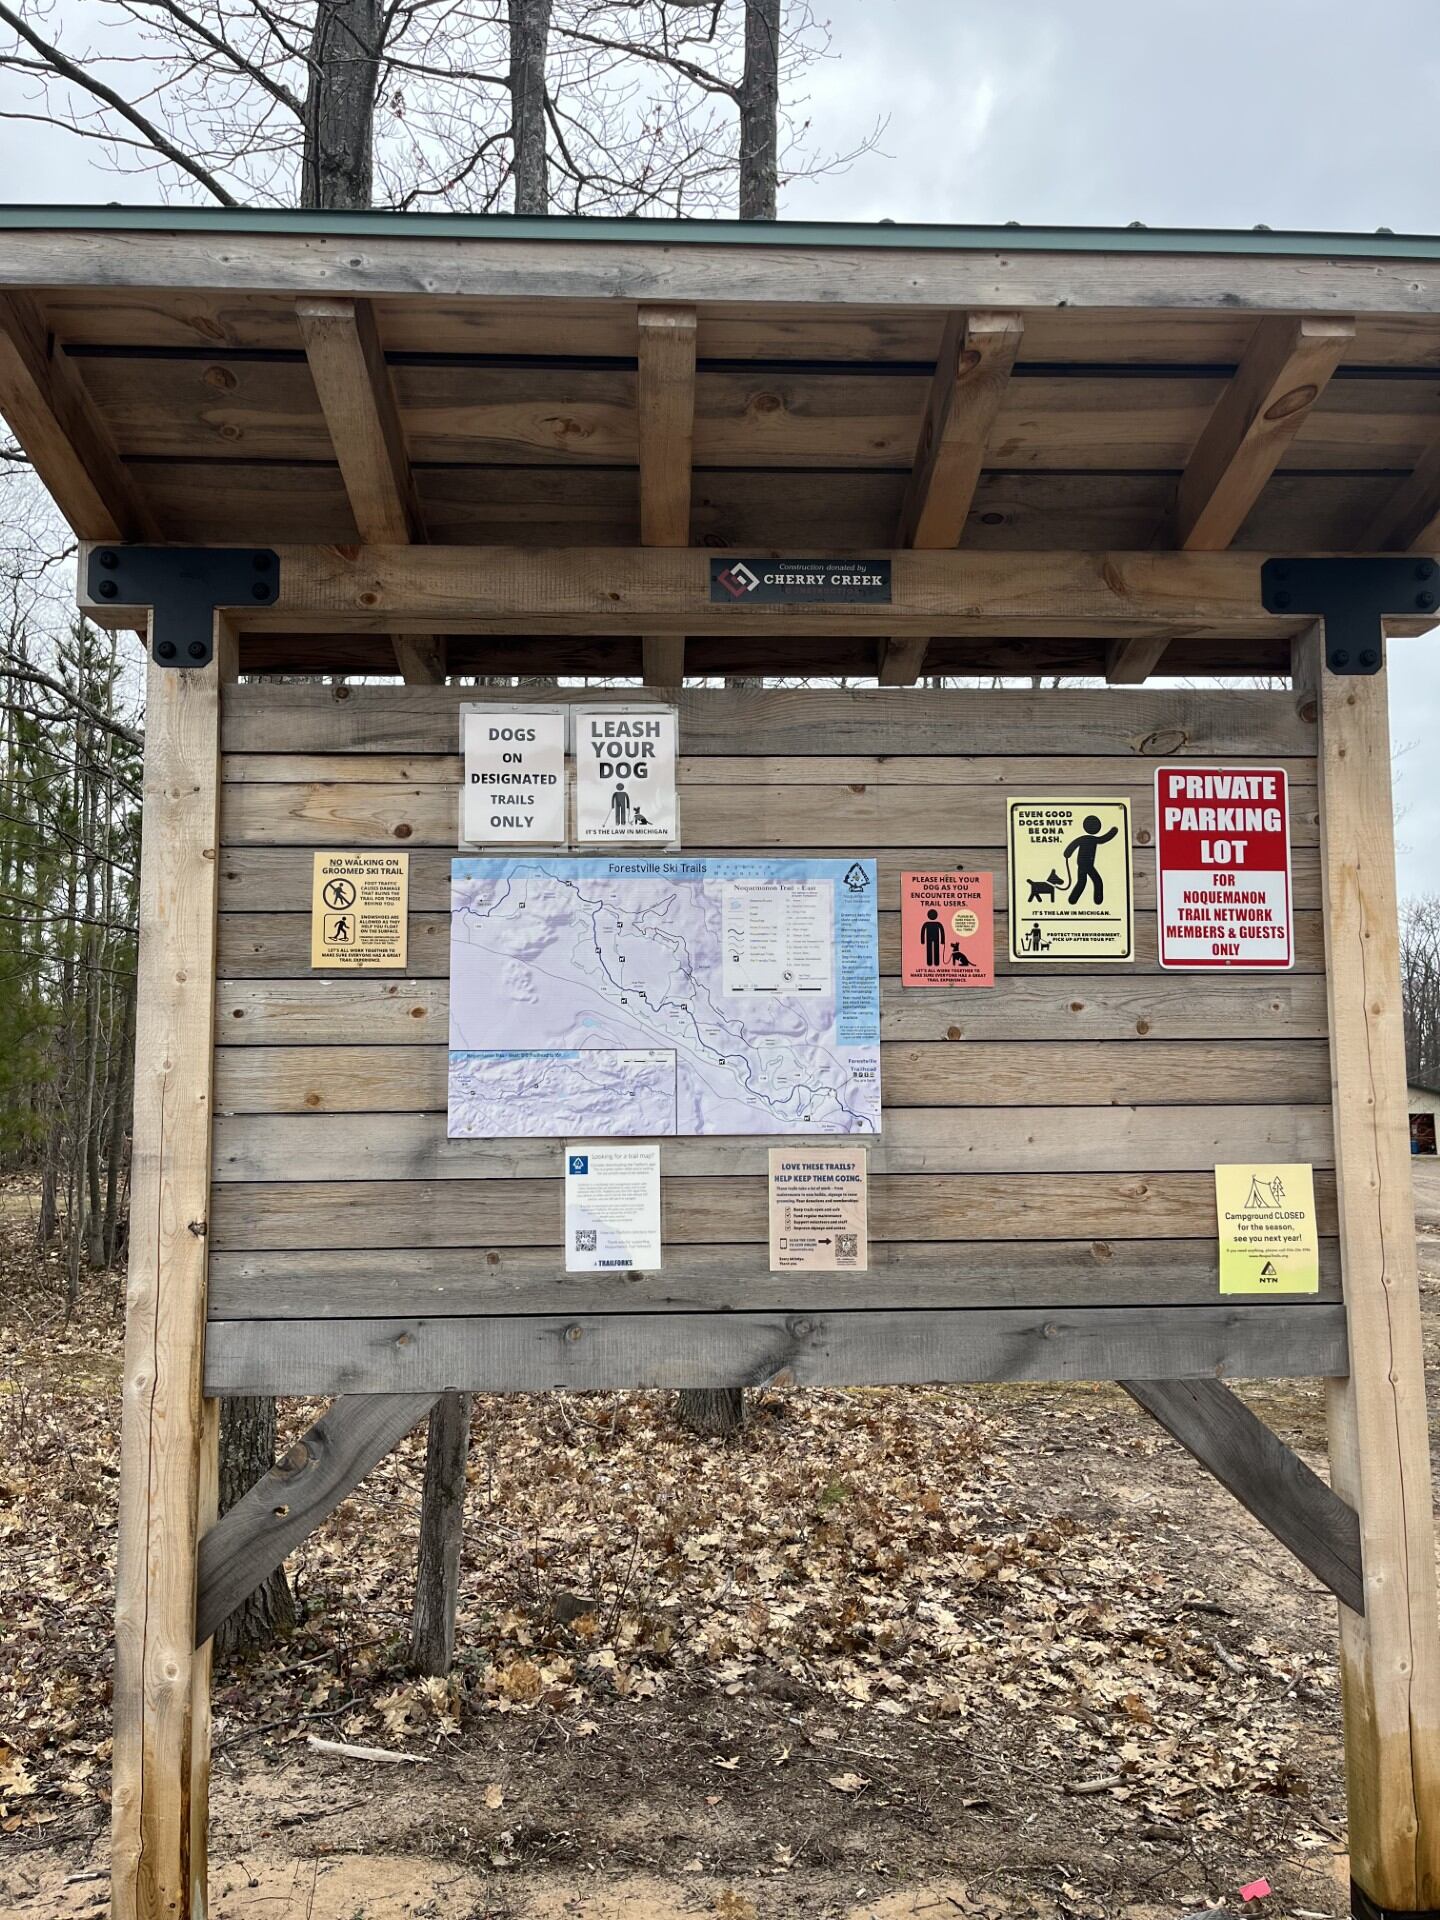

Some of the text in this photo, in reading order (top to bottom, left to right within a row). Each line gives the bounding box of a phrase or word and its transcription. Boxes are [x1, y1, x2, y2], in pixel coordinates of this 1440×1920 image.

[779, 563, 824, 571] Construction
[857, 564, 866, 572] by
[764, 575, 882, 586] CHERRY CREEK
[489, 728, 536, 741] DOGS
[592, 721, 660, 737] LEASH
[591, 742, 656, 758] YOUR
[503, 753, 522, 763] ON
[600, 762, 648, 779] DOG
[472, 774, 557, 784] DESIGNATED
[1169, 775, 1277, 800] PRIVATE
[490, 795, 534, 805] TRAILS
[491, 816, 534, 828] ONLY
[1165, 807, 1281, 832] PARKING
[1201, 840, 1248, 864] LOT
[609, 863, 707, 873] Forestville Ski Trails
[1213, 874, 1236, 887] FOR
[1184, 891, 1266, 905] NOQUEMANON
[1178, 908, 1273, 922] TRAIL NETWORK
[1166, 926, 1285, 939] MEMBERS & GUESTS
[1212, 944, 1240, 956] ONLY
[640, 1152, 654, 1160] map?
[1225, 1212, 1305, 1221] Campground CLOSED
[1283, 1234, 1302, 1243] year!
